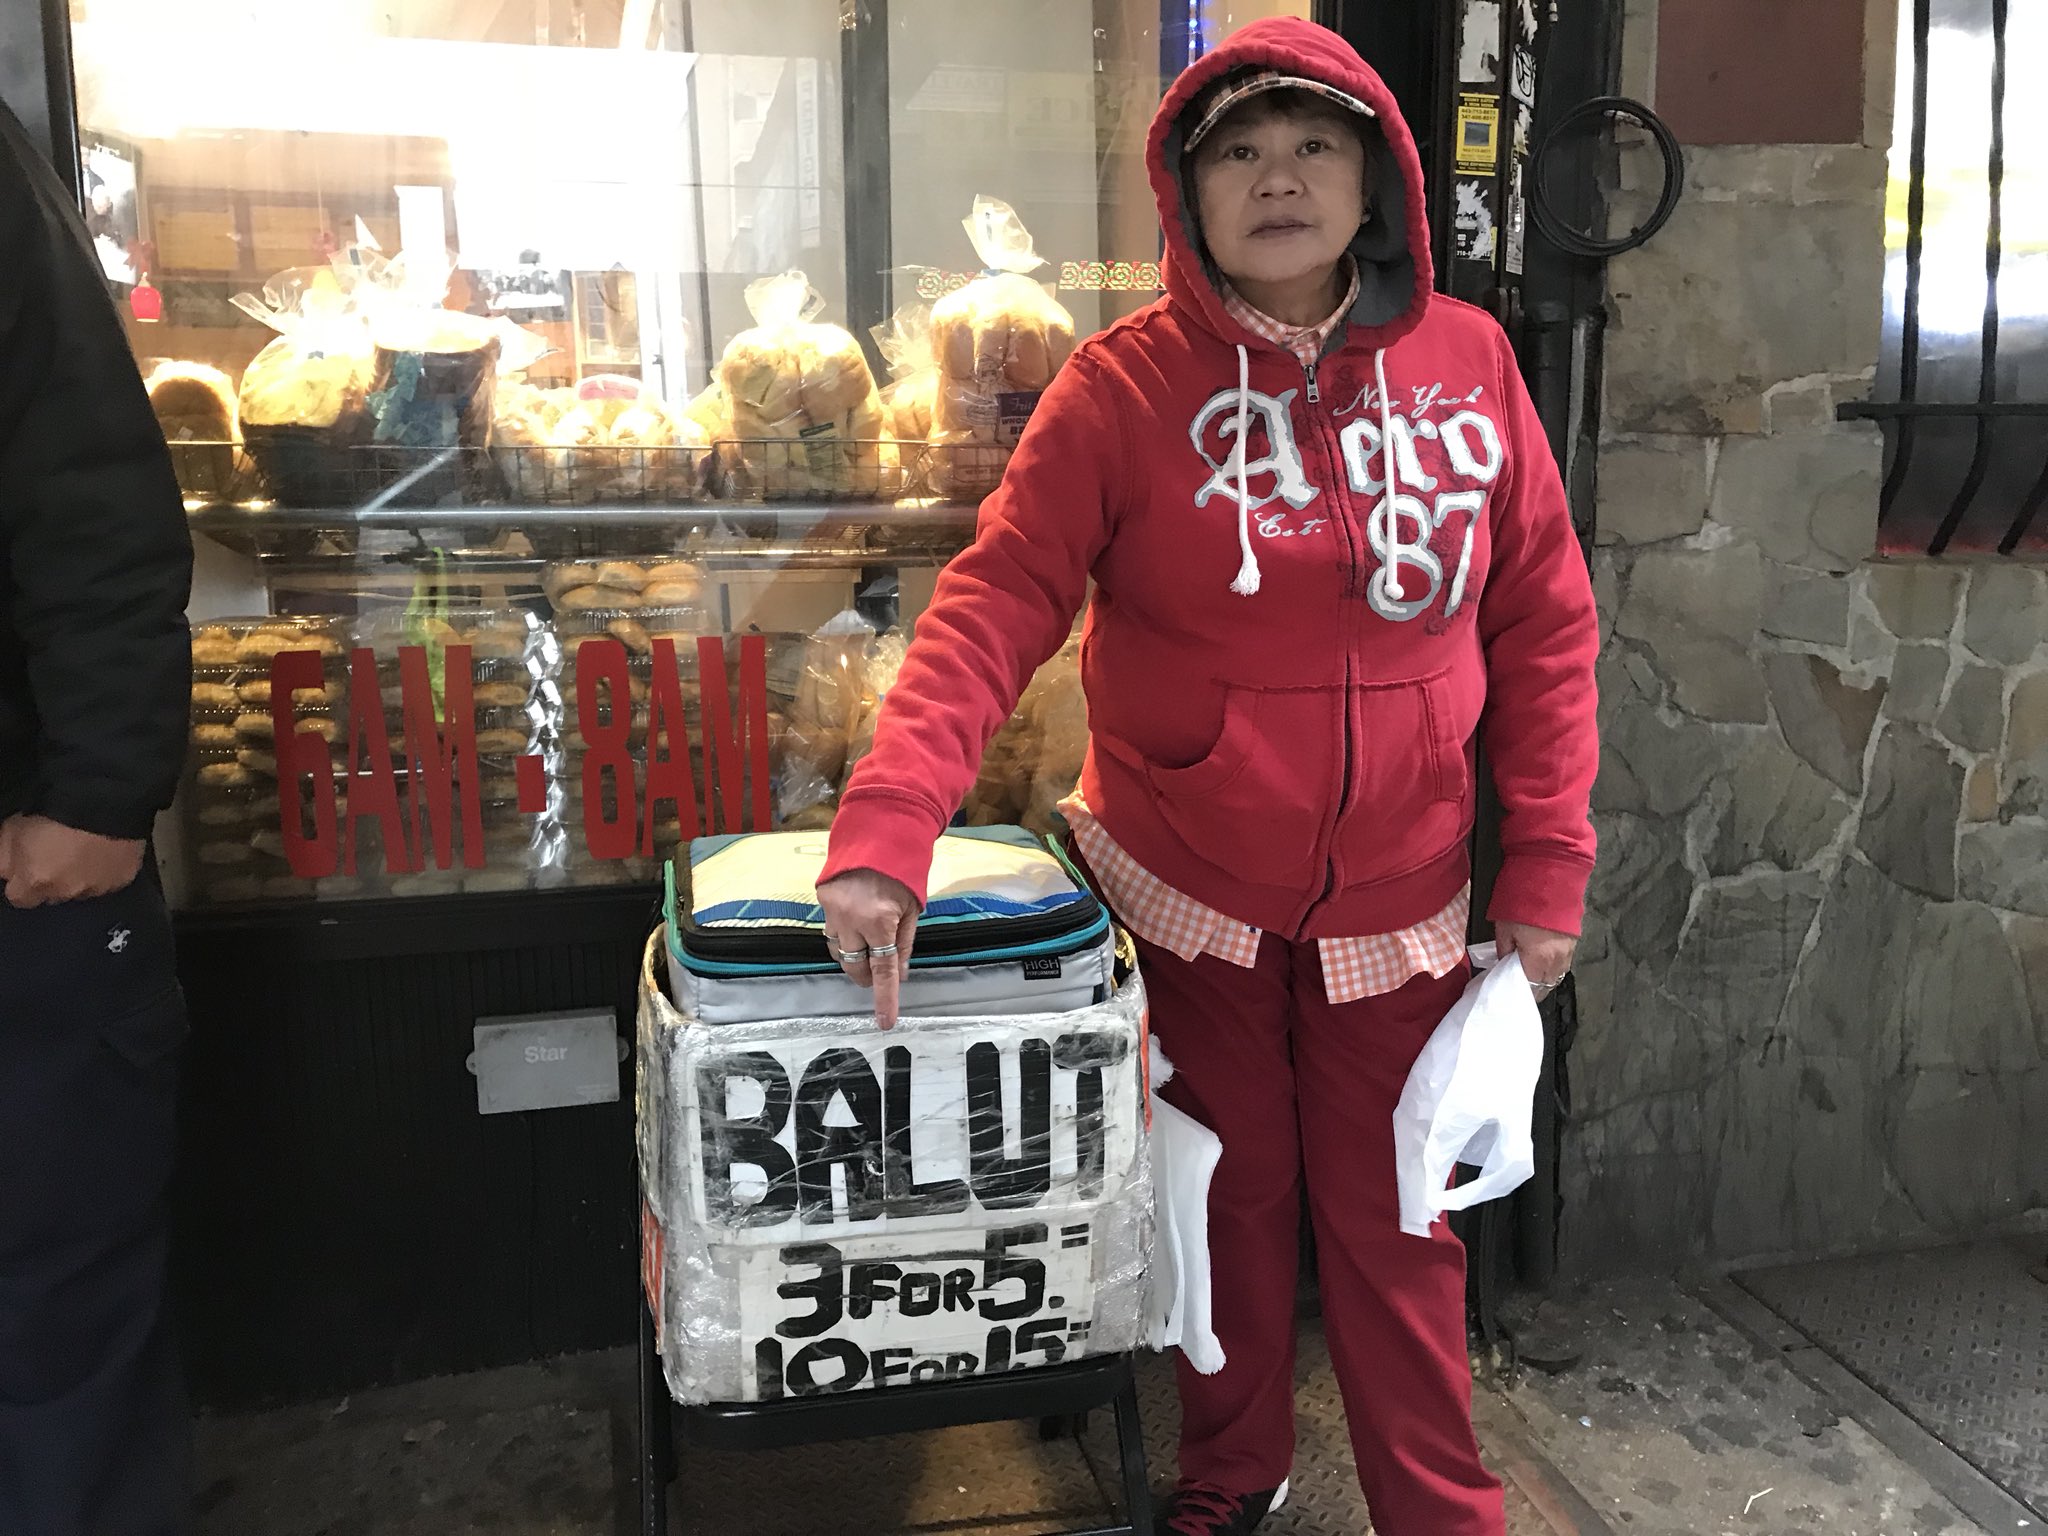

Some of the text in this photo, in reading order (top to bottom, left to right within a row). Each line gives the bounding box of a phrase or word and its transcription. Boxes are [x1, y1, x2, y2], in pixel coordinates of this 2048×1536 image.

[1410, 382, 1484, 418] York
[1188, 388, 1503, 510] Aero
[1367, 490, 1487, 621] 87
[271, 645, 486, 878] 6AM
[576, 636, 772, 859] 8AM
[1024, 959, 1060, 970] HIGH
[524, 1046, 568, 1064] Star
[697, 1033, 1128, 1228] BALUT
[775, 1242, 843, 1339] 3
[848, 1263, 975, 1320] FOR
[755, 1336, 869, 1400] 10
[870, 1347, 979, 1388] FOR
